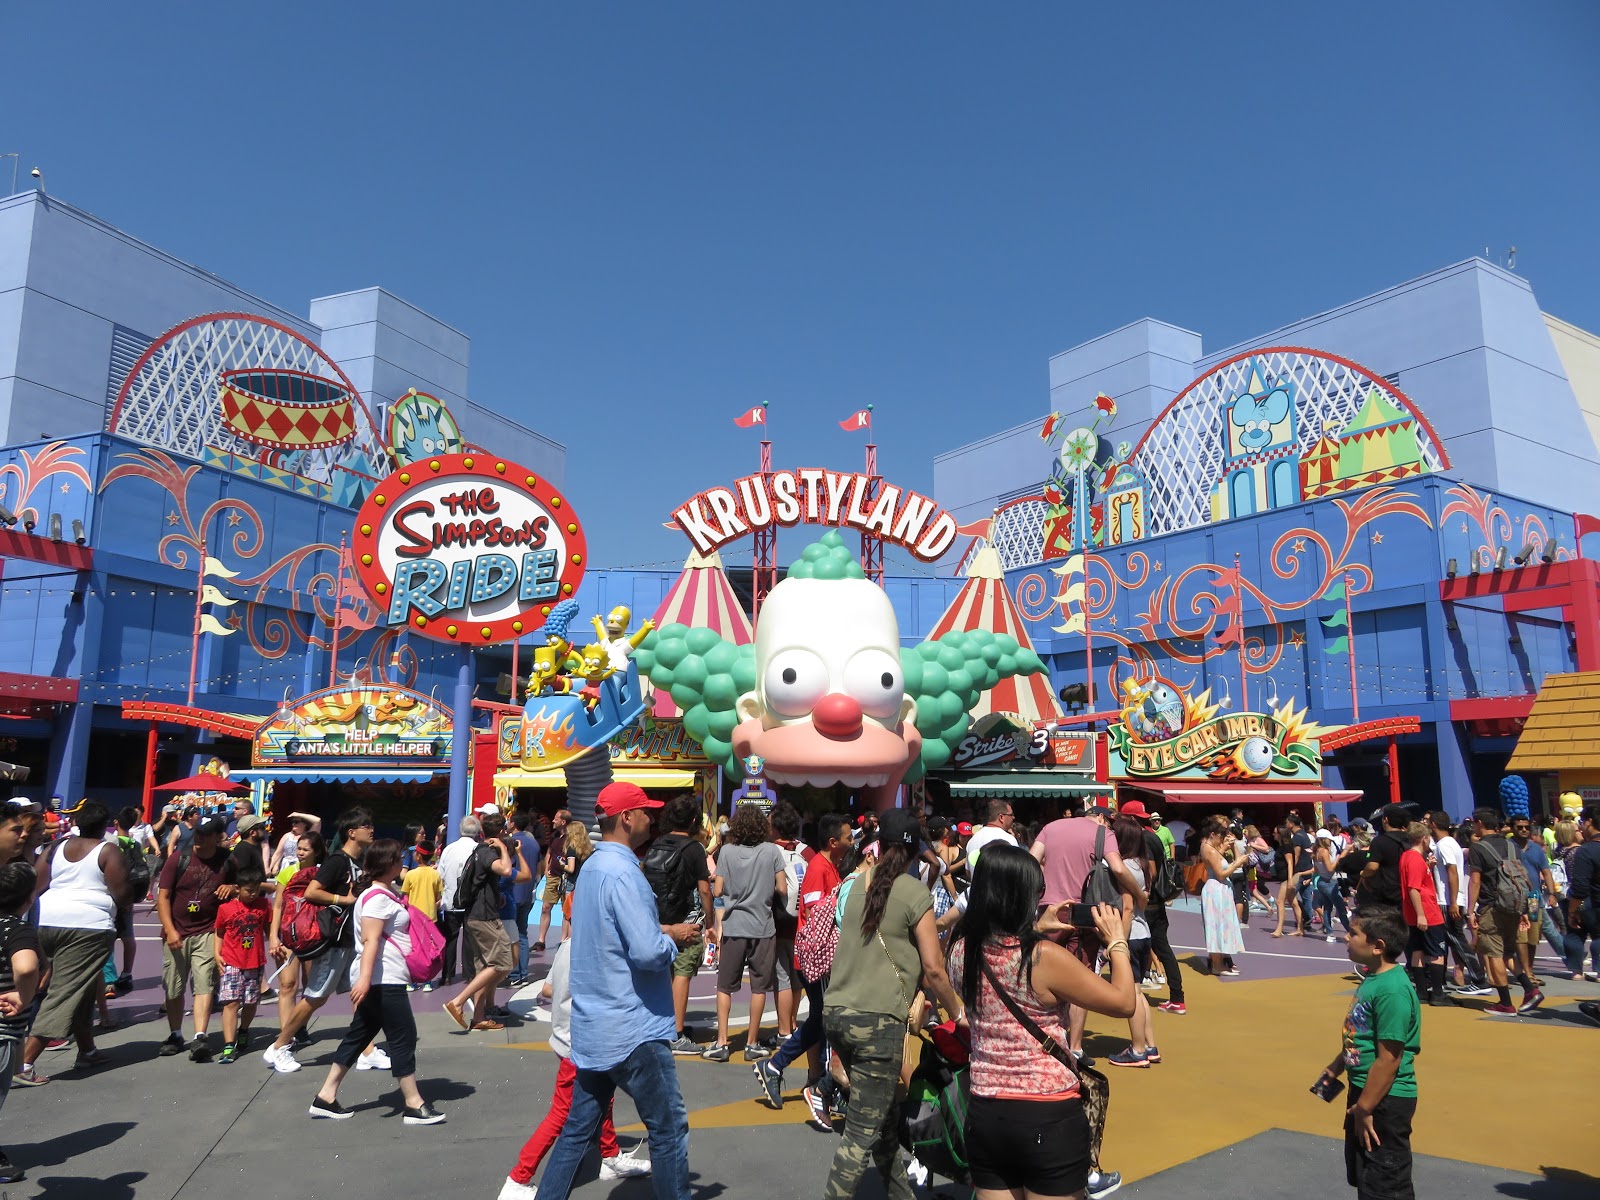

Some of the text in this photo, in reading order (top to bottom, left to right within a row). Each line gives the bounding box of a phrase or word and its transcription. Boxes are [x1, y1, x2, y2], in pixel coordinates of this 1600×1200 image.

[752, 408, 762, 423] K
[858, 411, 868, 426] K
[440, 487, 500, 517] THE
[672, 468, 958, 562] KRUSTYLAND
[392, 500, 549, 557] SIMPSONS
[387, 549, 560, 625] RIDE
[291, 743, 432, 755] SANTA'S LITTLE HELPER
[344, 730, 378, 741] HELP
[526, 728, 545, 758] K
[955, 730, 1049, 763] Strike 3
[1130, 744, 1175, 770] EYE
[903, 832, 912, 843] LA
